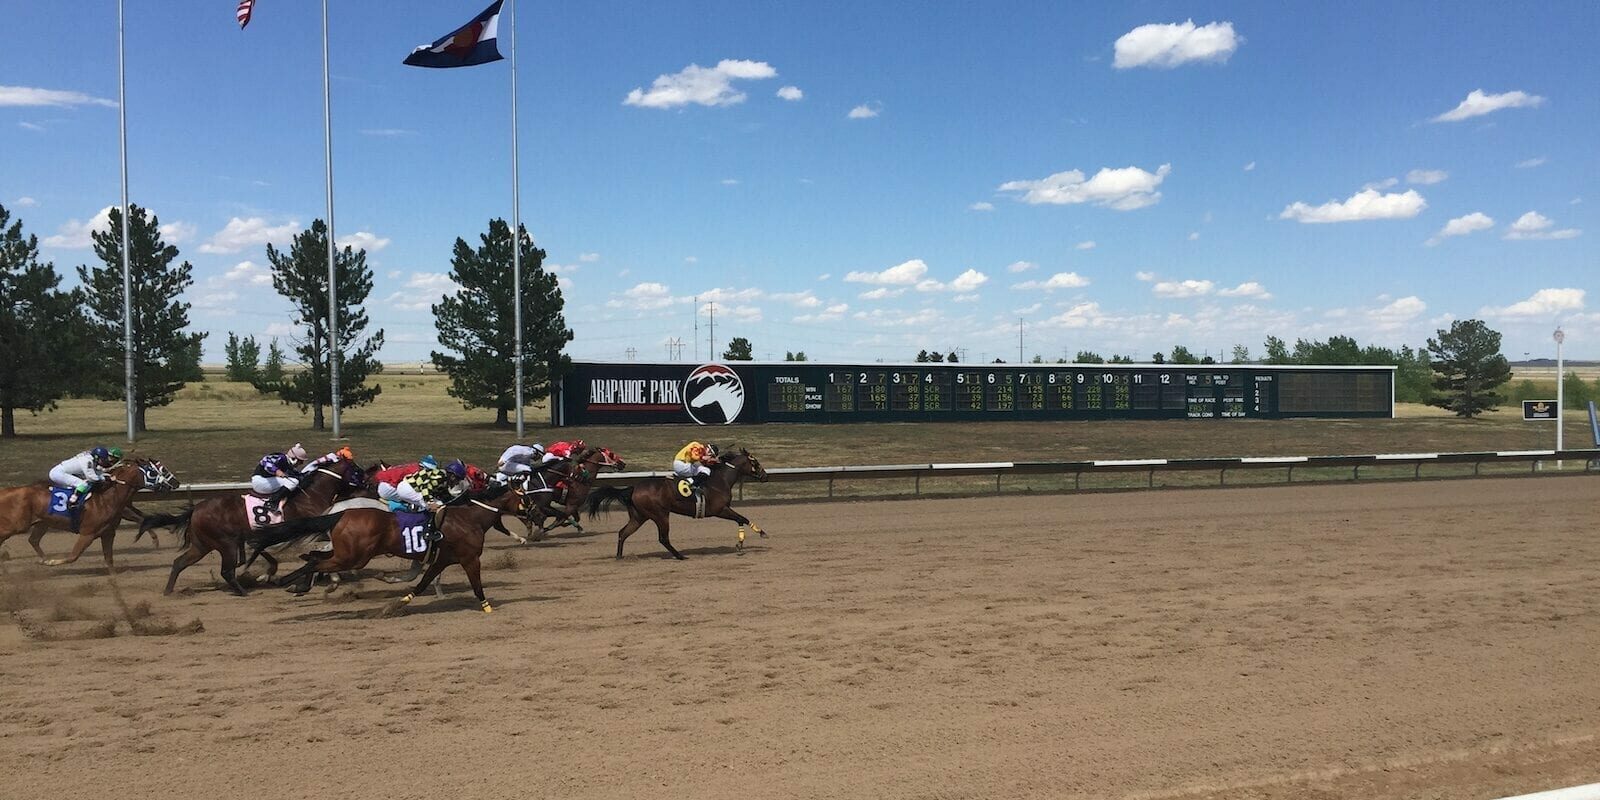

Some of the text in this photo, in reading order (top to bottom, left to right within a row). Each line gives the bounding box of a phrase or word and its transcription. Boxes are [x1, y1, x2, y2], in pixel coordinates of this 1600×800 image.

[775, 376, 800, 384] TOTALS
[829, 373, 834, 383] 1
[845, 374, 852, 383] 7
[860, 373, 867, 383] 2
[879, 374, 885, 383] 7
[893, 373, 900, 383] 3
[925, 373, 933, 383] 4
[957, 373, 964, 383] 5
[988, 373, 995, 383] 6
[1005, 375, 1012, 384] 5
[1019, 373, 1025, 383] 7
[1049, 373, 1055, 383] 8
[1065, 375, 1072, 384] 8
[1077, 373, 1084, 383] 9
[1094, 375, 1100, 384] 5
[1102, 373, 1113, 383] 10
[1133, 374, 1142, 384] 11
[1160, 374, 1170, 384] 12
[1205, 375, 1211, 384] 5
[589, 379, 682, 404] ARAPAHOE PARK
[678, 480, 692, 497] 6
[53, 492, 68, 512] 3
[253, 506, 271, 525] 8
[402, 525, 427, 553] 10
